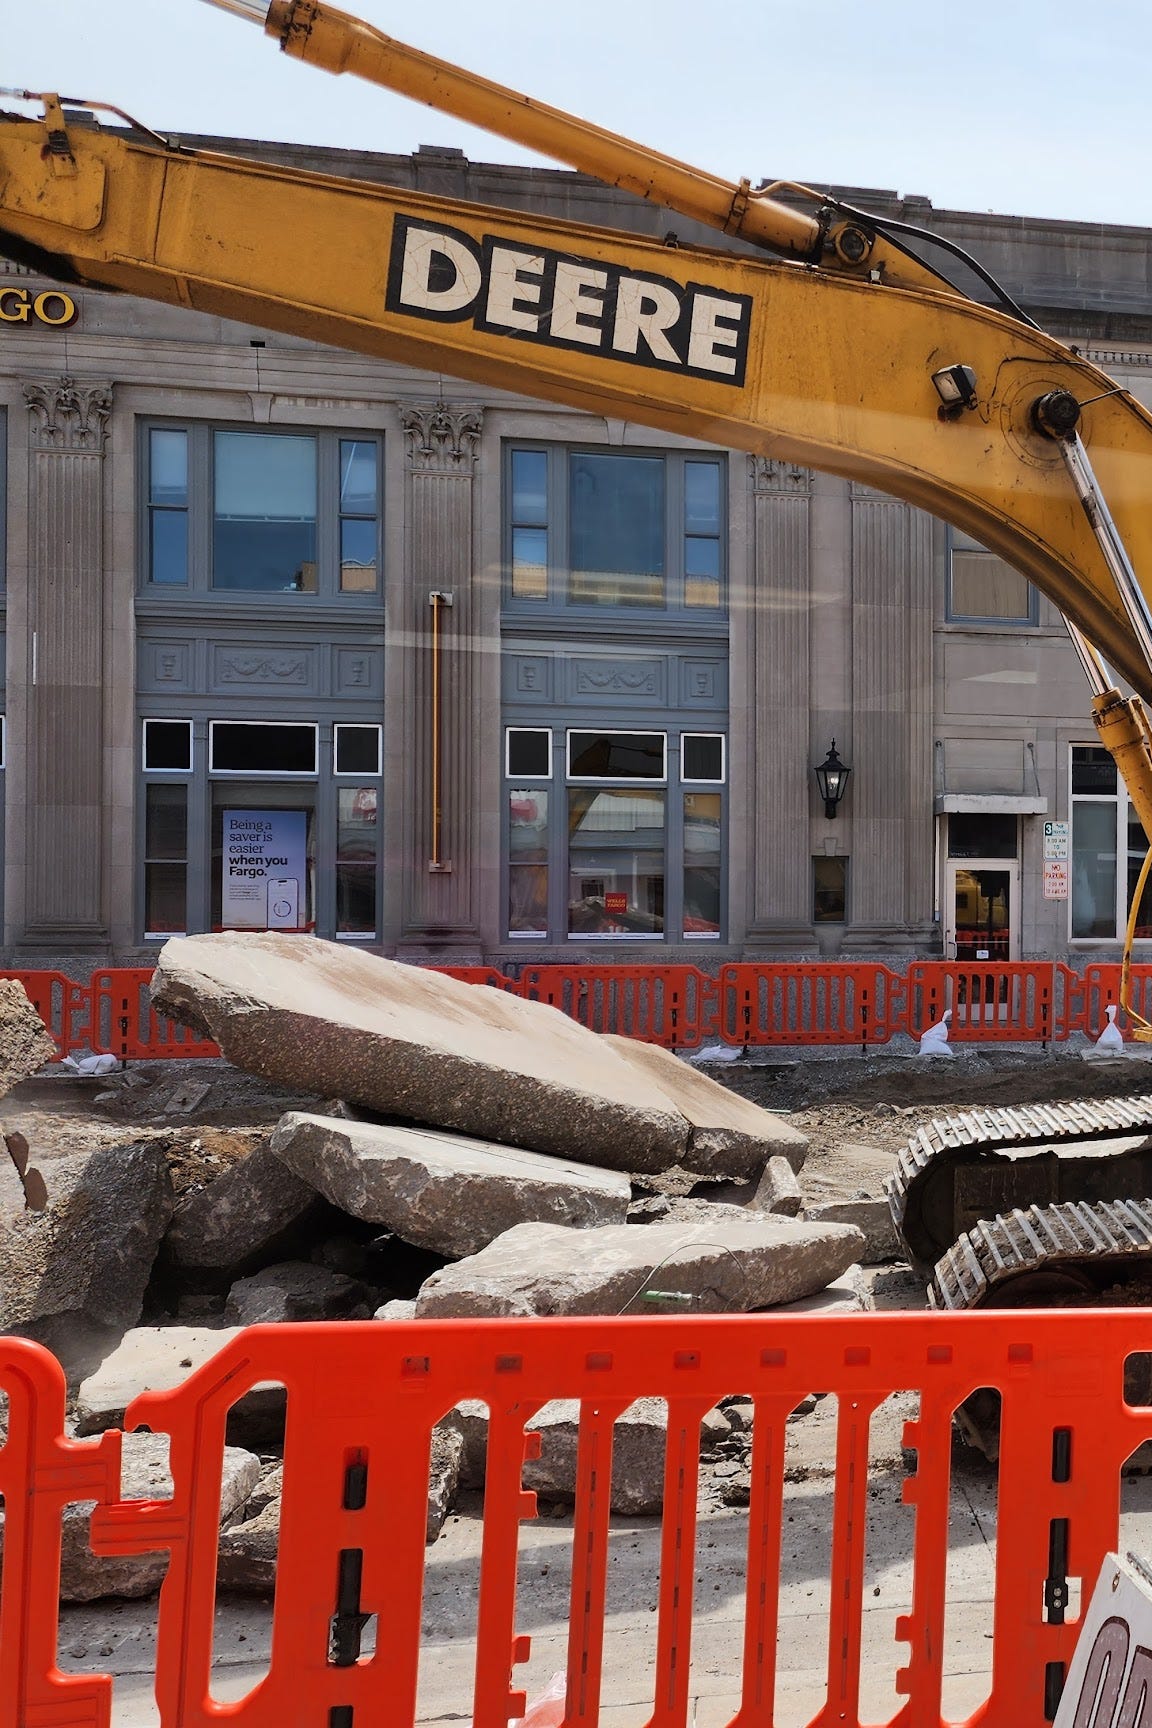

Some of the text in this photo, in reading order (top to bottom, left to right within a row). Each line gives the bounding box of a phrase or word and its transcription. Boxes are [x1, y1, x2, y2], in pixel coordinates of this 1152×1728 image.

[398, 226, 744, 376] DEERE
[230, 819, 272, 833] Being a
[229, 831, 273, 842] saver is
[229, 843, 264, 853] easier
[229, 855, 288, 868] when you
[229, 866, 267, 879] Fargo.
